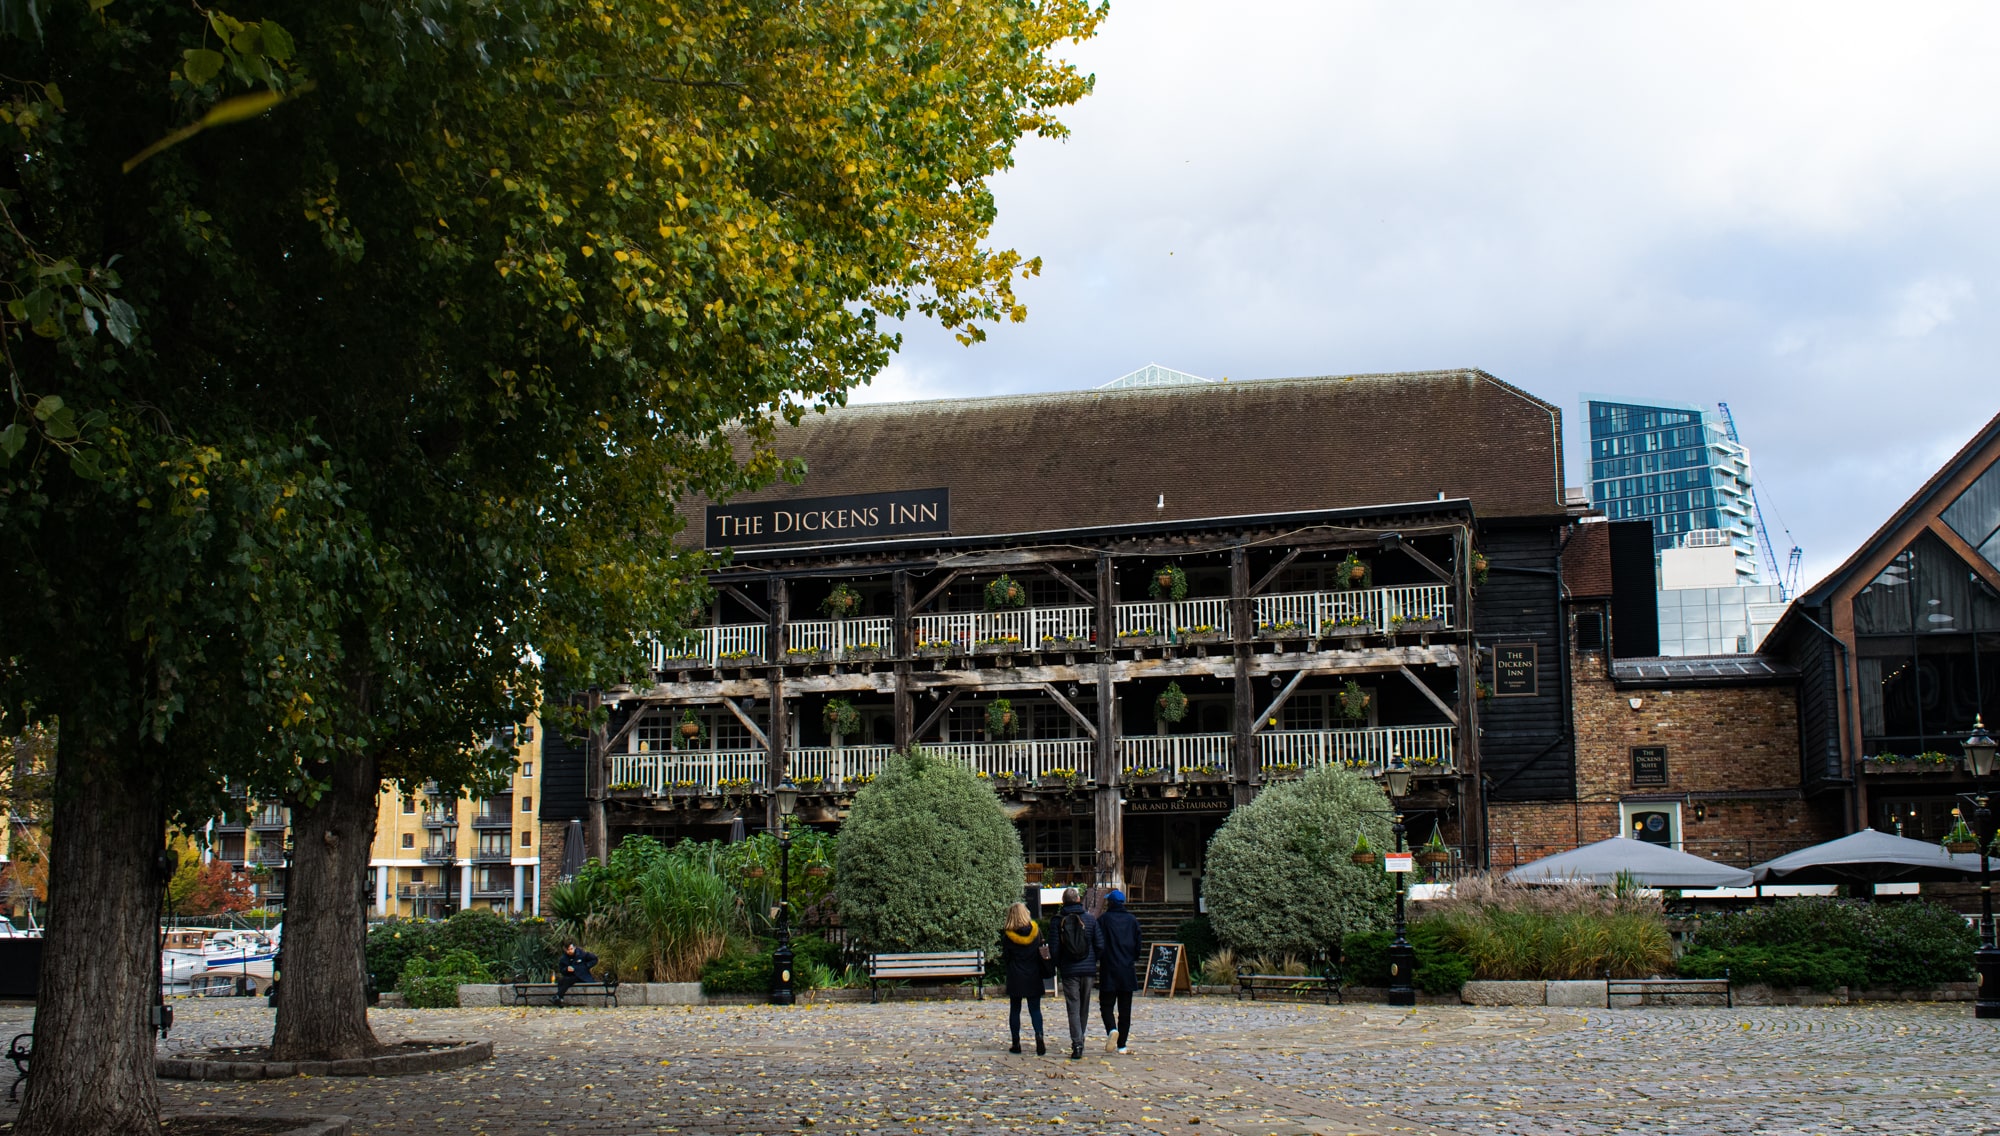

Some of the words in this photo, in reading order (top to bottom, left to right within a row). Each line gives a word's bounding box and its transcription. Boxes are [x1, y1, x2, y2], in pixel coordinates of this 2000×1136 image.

[716, 515, 763, 537] THE
[773, 507, 879, 533] DICKENS
[889, 502, 938, 525] INN
[1507, 651, 1523, 659] THE
[1498, 660, 1532, 668] DICKENS
[1132, 803, 1148, 811] BAR
[1149, 803, 1168, 811] AND
[1170, 801, 1227, 810] RESTAURANTS
